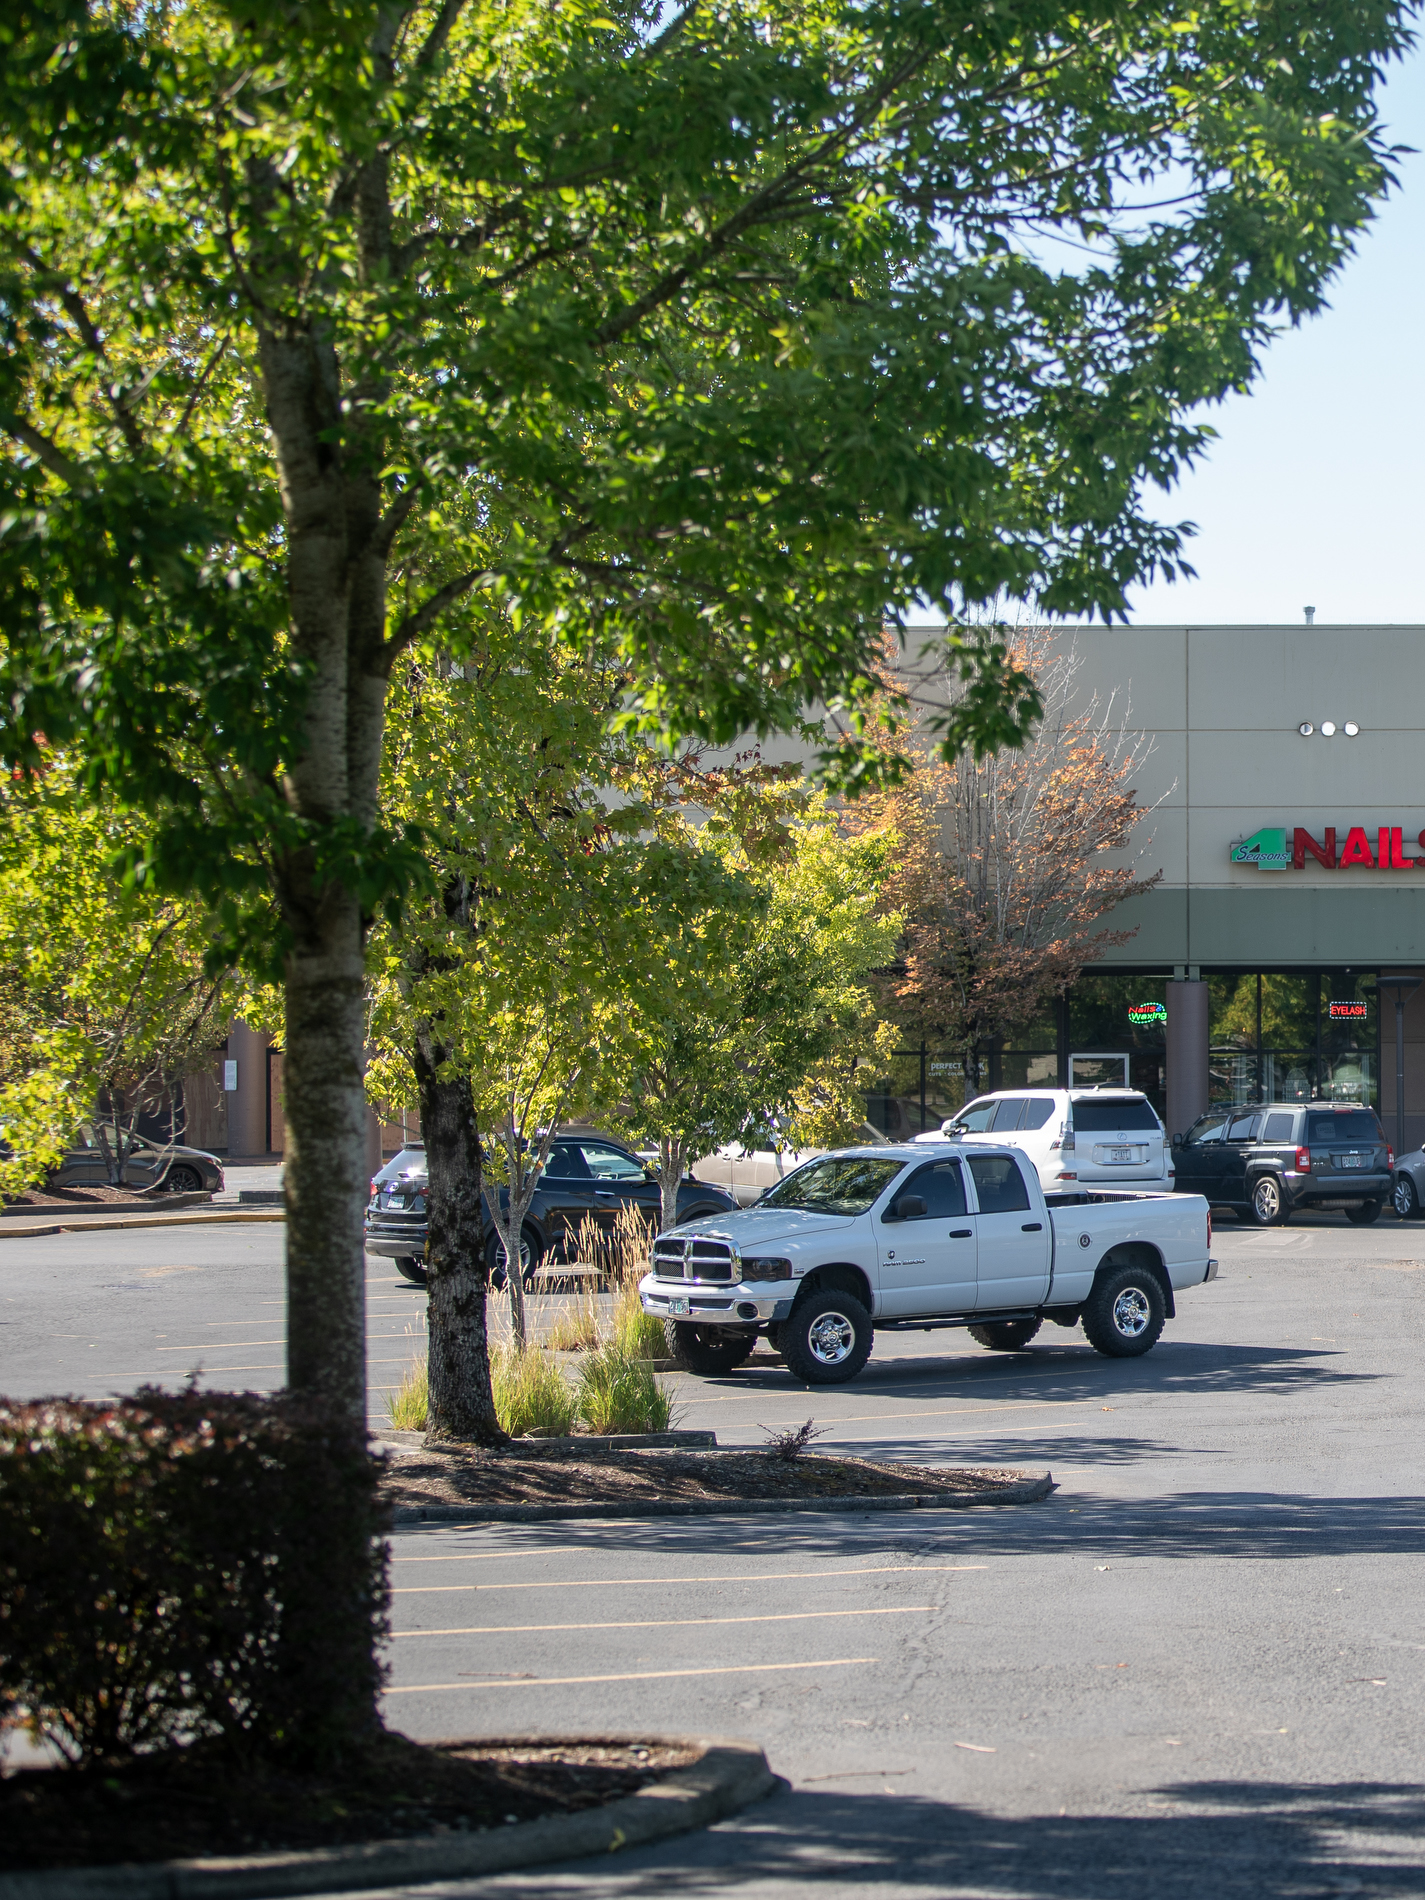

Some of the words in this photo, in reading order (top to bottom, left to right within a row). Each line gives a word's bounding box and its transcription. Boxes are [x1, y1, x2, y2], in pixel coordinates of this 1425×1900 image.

[1231, 827, 1291, 870] 4
[1236, 845, 1289, 861] Seasons
[1128, 1006, 1156, 1014] Nails
[1331, 1005, 1366, 1015] EYELASH
[1131, 1012, 1167, 1021] Waxing
[930, 1062, 962, 1071] PERFECT
